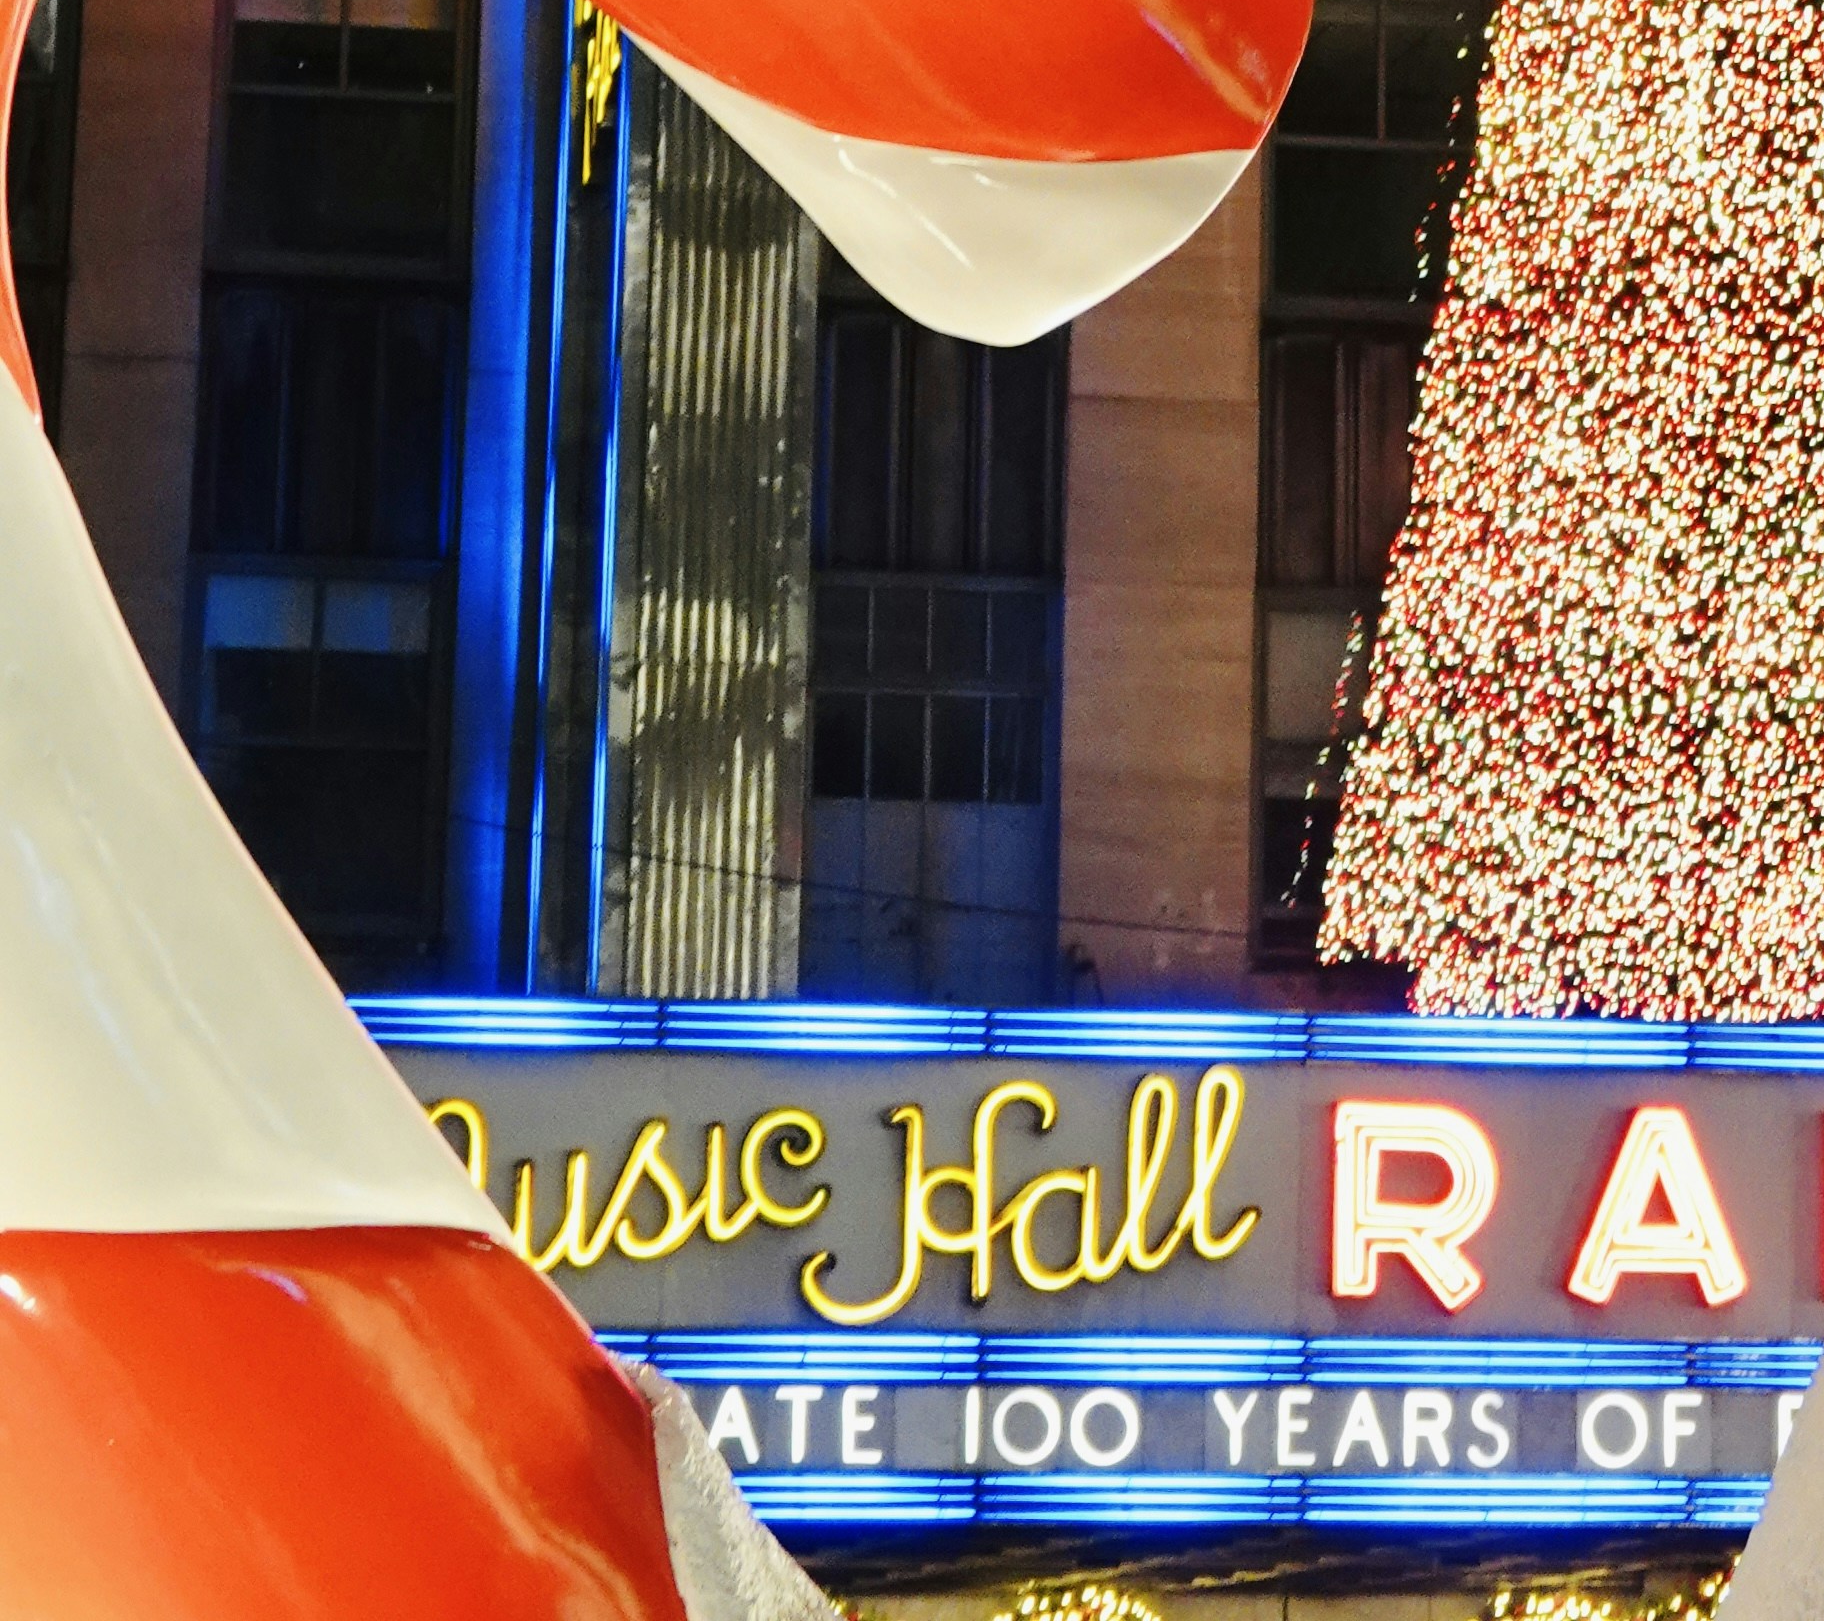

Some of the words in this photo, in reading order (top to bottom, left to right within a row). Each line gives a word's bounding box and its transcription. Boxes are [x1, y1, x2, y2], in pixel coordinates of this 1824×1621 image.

[800, 1063, 1258, 1325] Hall
[964, 1386, 1140, 1467] 100
[1214, 1388, 1510, 1469] YEARS
[1580, 1391, 1702, 1470] OF
